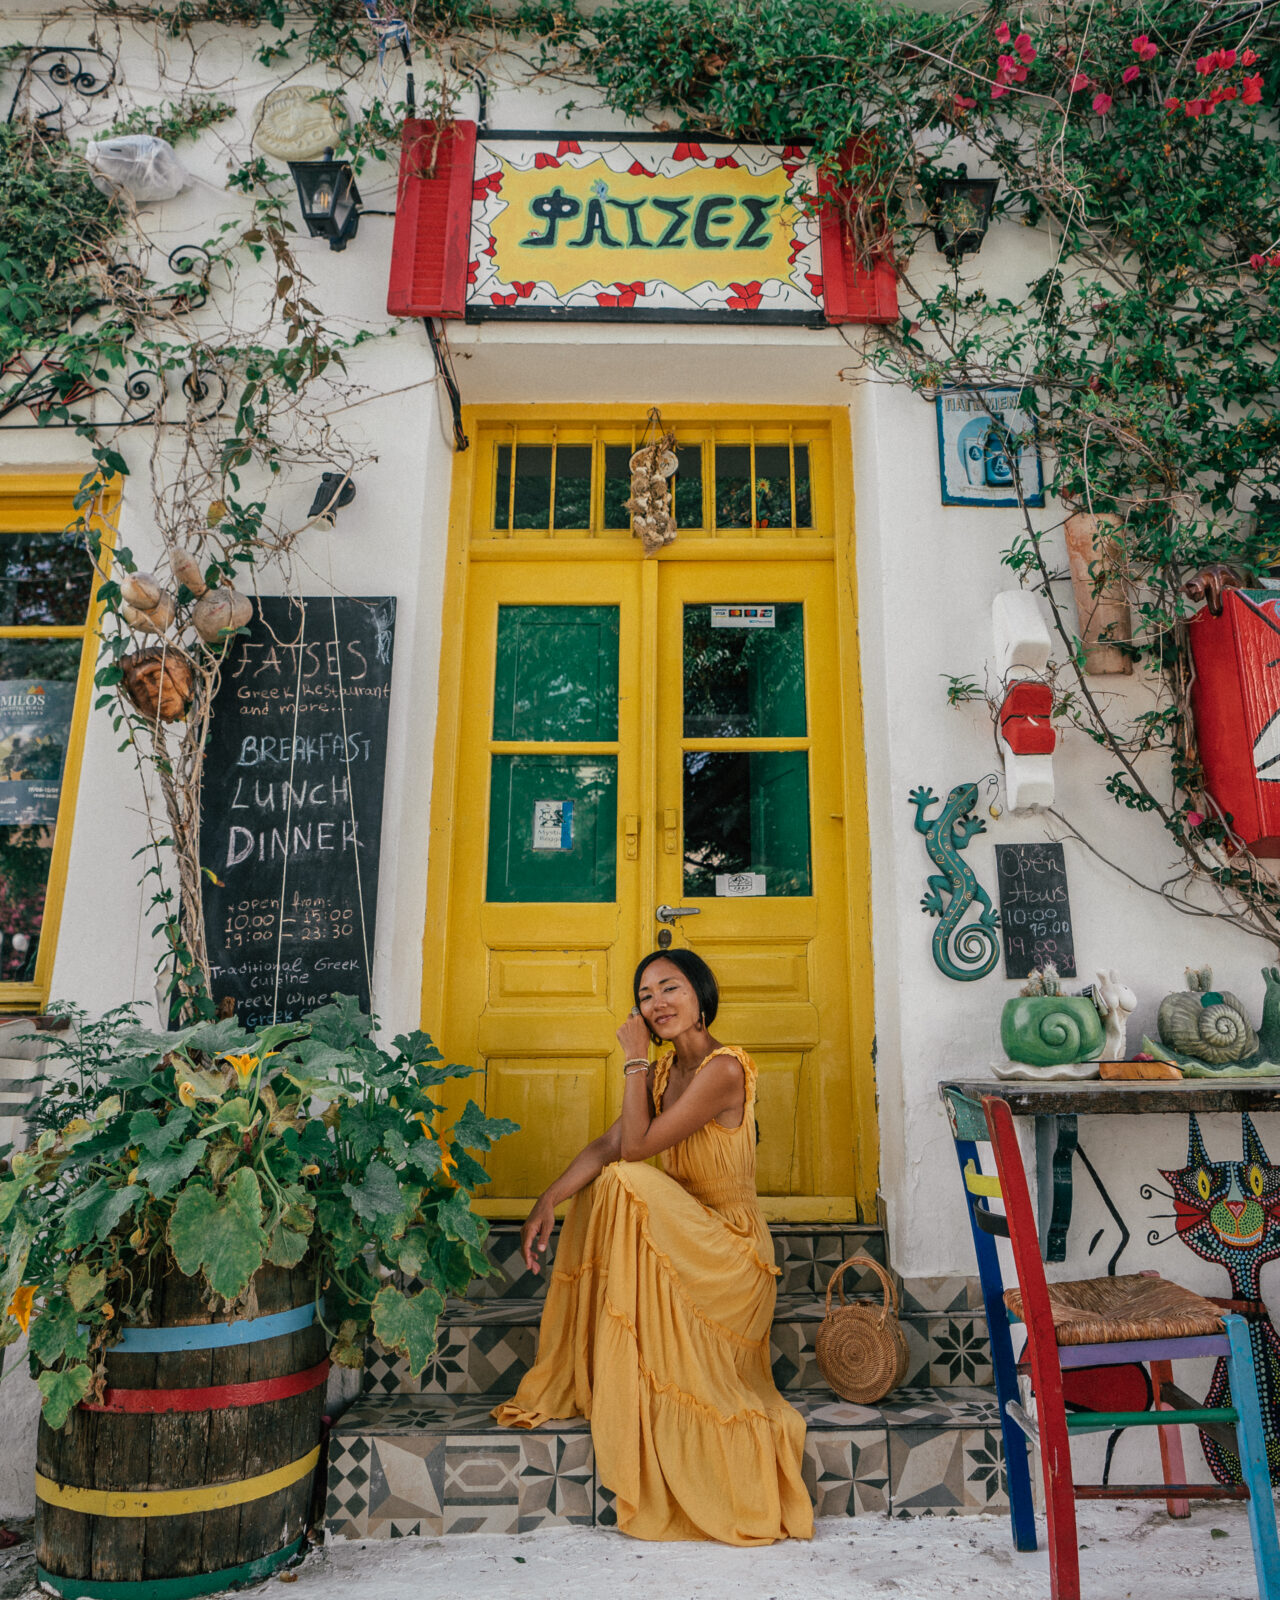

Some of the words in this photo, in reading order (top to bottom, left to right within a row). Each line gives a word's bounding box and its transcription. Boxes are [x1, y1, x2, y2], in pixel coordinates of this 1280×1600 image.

[232, 640, 367, 680] FATSES
[0, 695, 45, 706] MILOS
[237, 684, 295, 699] Greek
[302, 682, 391, 699] Restaurant
[240, 702, 268, 715] and
[236, 732, 371, 766] BREAKFAST
[231, 775, 350, 812] LUNCH
[226, 820, 365, 867] DINNER
[1000, 847, 1065, 879] Open
[1004, 880, 1068, 905] Hours
[304, 909, 353, 923] 15:00
[225, 931, 272, 949] 19:00
[301, 924, 353, 940] 23:30
[210, 957, 302, 979] Traditional
[314, 957, 360, 972] Greek
[250, 972, 310, 988] cuisine
[234, 994, 273, 1009] reek
[246, 1010, 293, 1027] Greek
